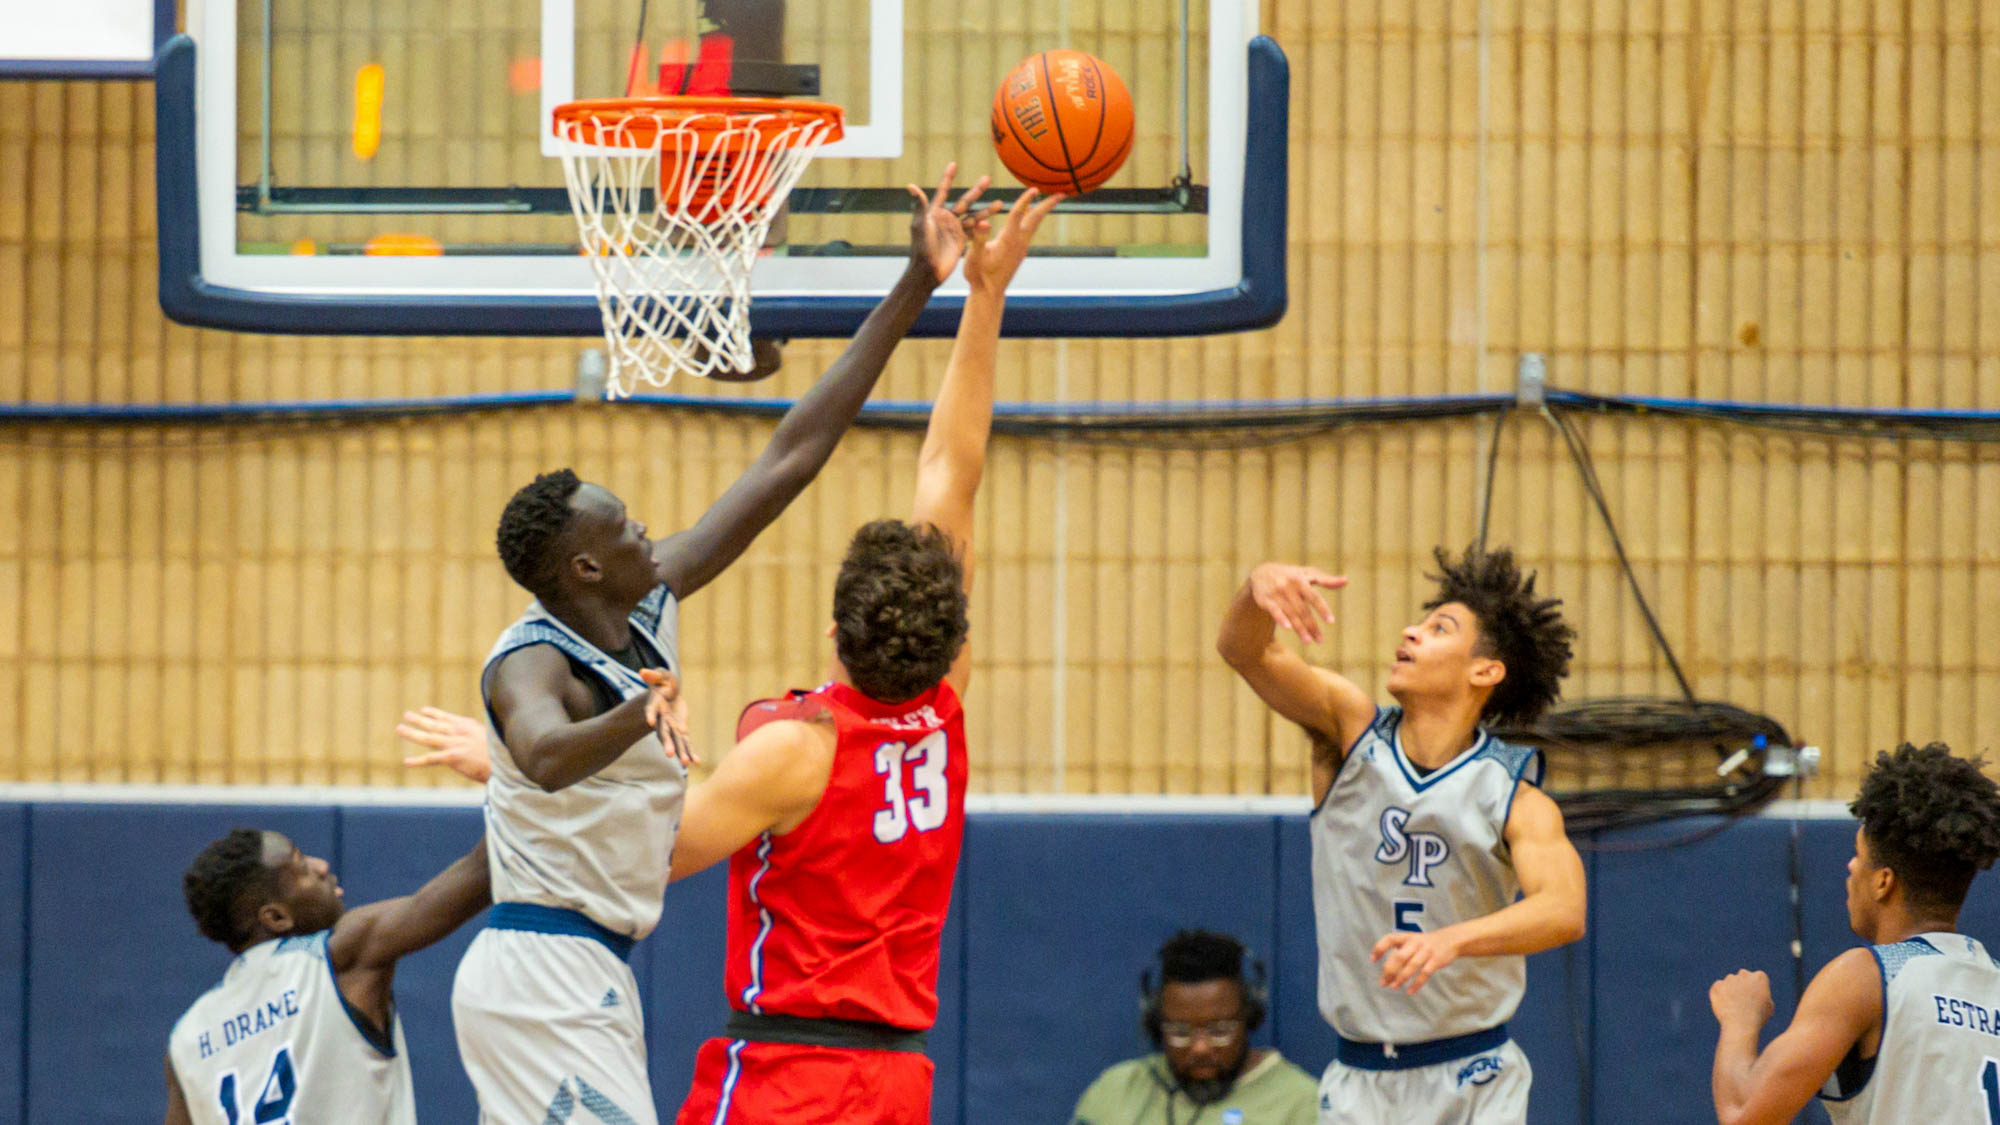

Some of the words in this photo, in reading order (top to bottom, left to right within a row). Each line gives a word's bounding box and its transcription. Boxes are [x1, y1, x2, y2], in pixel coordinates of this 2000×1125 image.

[1014, 95, 1048, 142] THE
[873, 728, 949, 844] 33
[1375, 806, 1450, 888] SP
[198, 1031, 220, 1059] H.
[223, 989, 299, 1047] DRAME
[219, 1046, 297, 1125] 14
